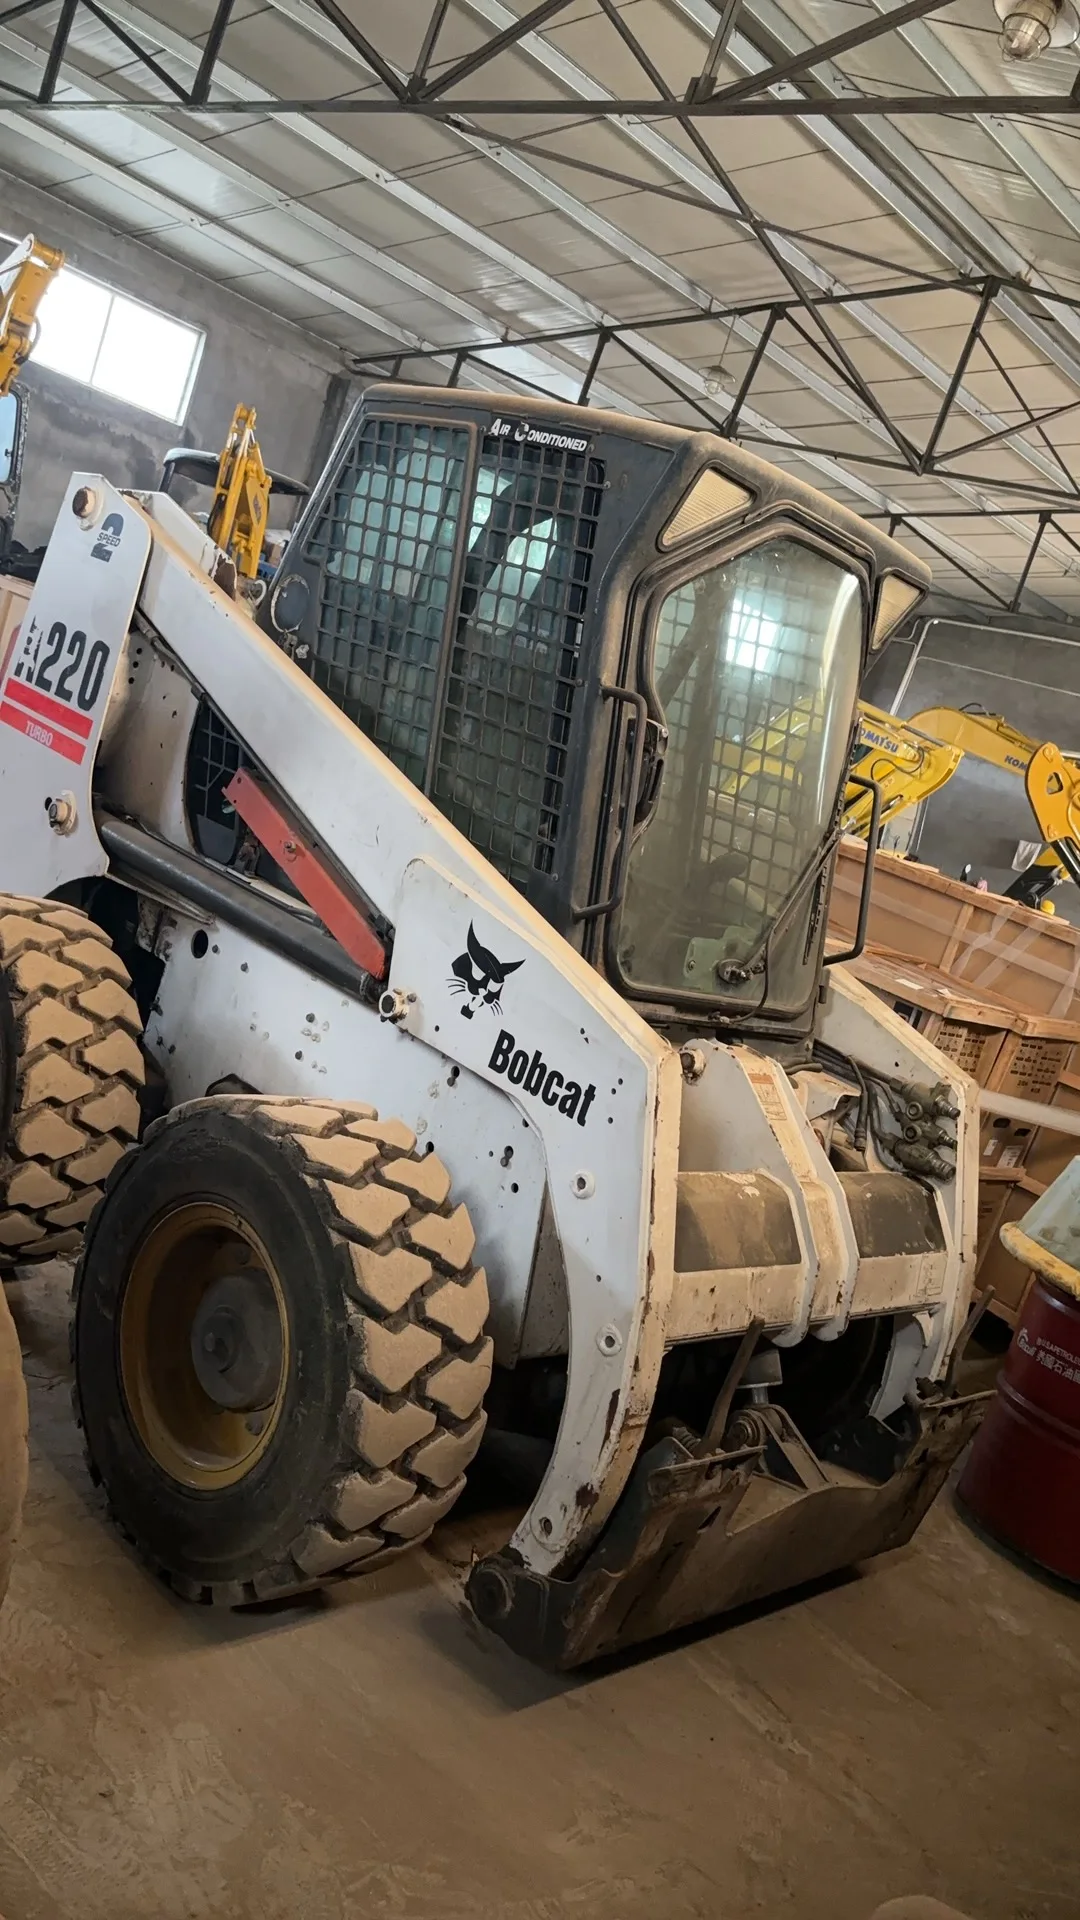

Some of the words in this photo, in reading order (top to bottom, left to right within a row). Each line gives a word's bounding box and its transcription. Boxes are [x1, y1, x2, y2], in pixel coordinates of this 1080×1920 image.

[488, 418, 511, 436] AIR
[514, 421, 588, 451] CONDITIONED
[97, 532, 121, 547] SPEED
[25, 720, 54, 747] TURBO
[860, 728, 899, 753] OMATSU
[1004, 754, 1028, 771] KOM
[488, 1028, 597, 1127] Bobcat
